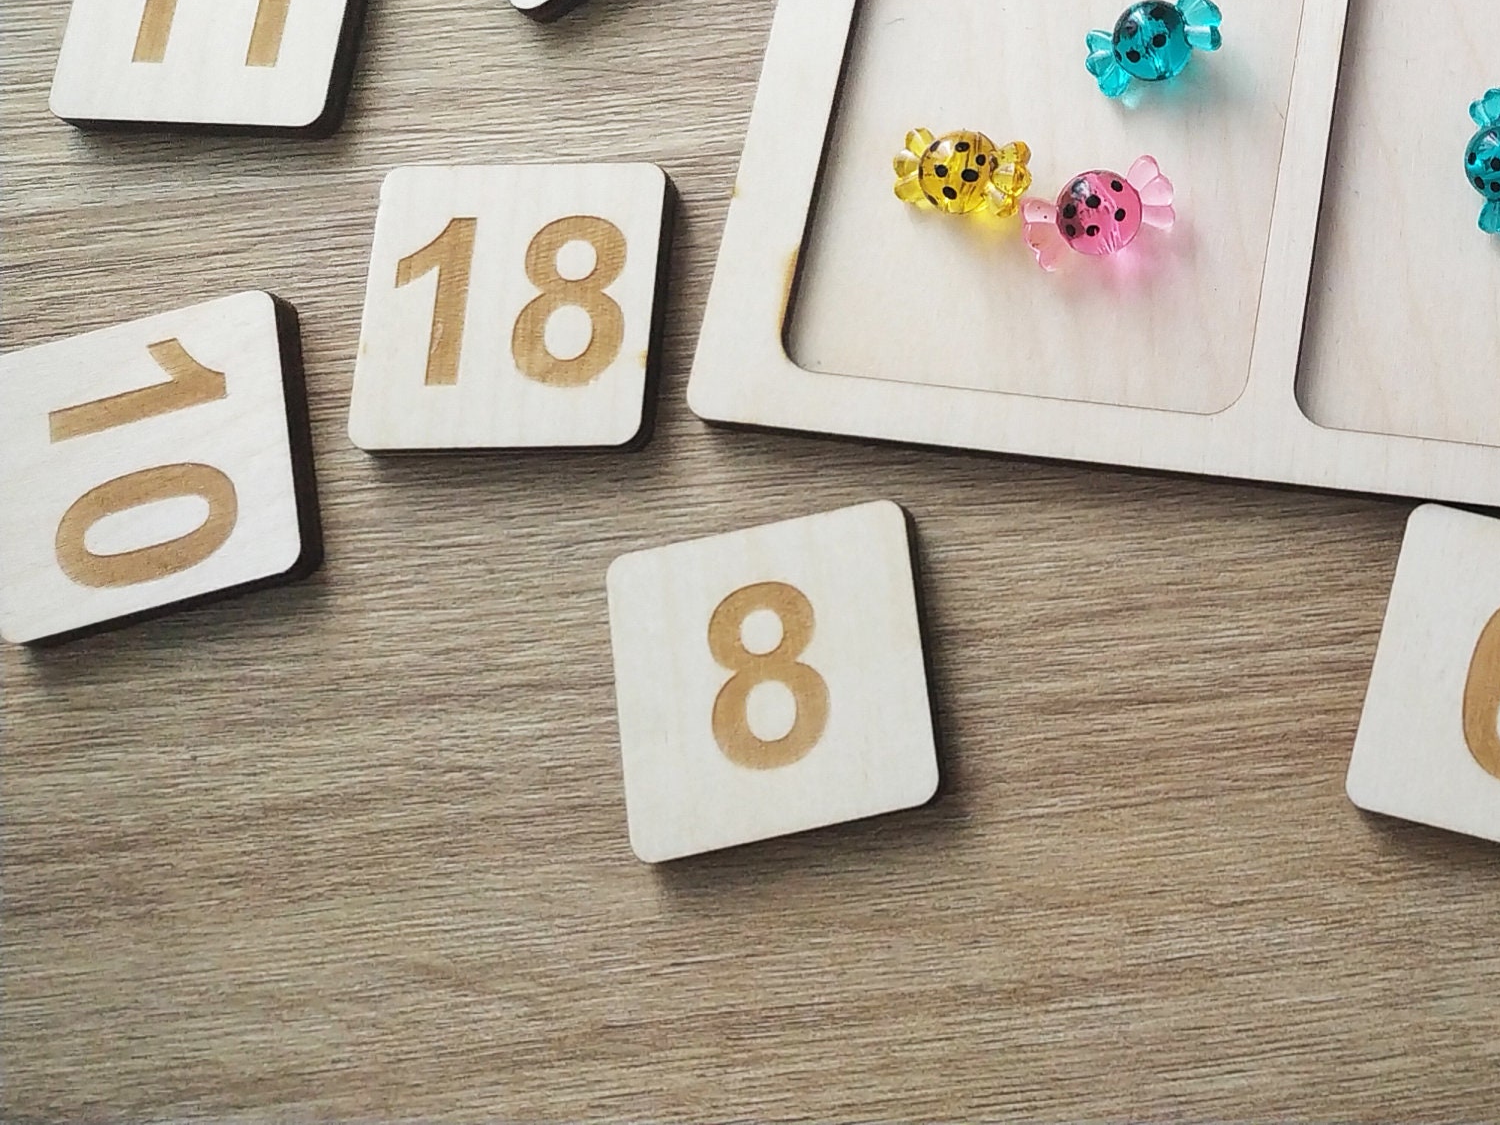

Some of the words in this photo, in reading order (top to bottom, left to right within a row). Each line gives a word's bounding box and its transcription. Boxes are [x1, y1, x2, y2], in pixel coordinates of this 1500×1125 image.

[395, 214, 627, 388] 18
[49, 337, 238, 588] 10
[707, 580, 829, 770] 8
